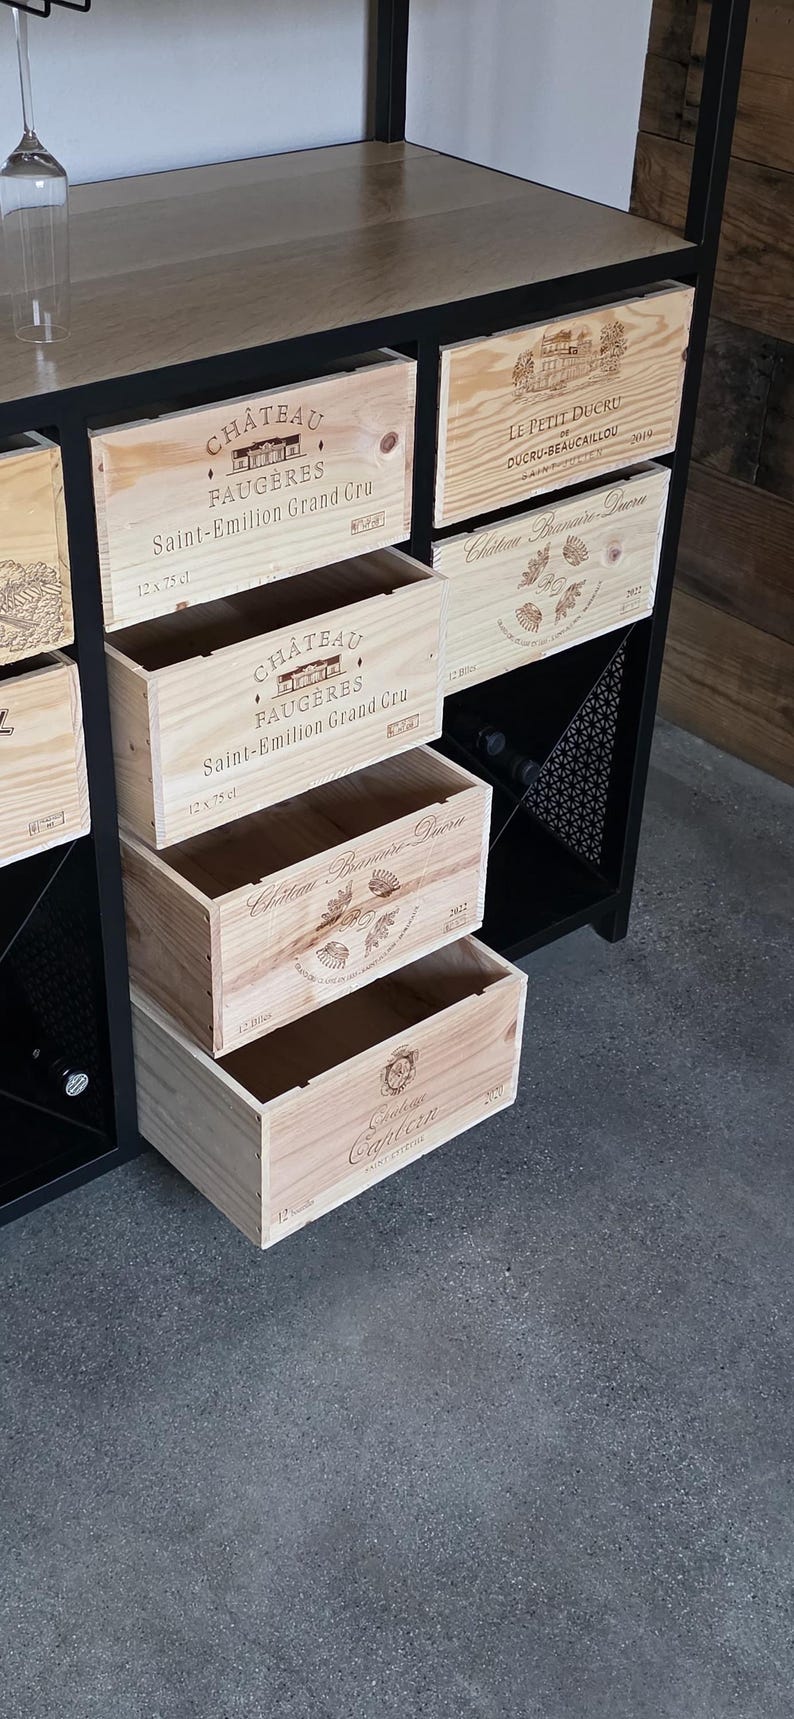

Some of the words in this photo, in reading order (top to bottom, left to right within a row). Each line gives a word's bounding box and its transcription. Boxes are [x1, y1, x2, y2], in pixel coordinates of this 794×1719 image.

[205, 403, 325, 456] CHÂTEAU
[509, 424, 525, 441] LE
[529, 411, 569, 436] PETIT
[571, 396, 621, 424] DUCRU
[560, 428, 570, 438] DE
[507, 425, 619, 470] DUCRU-BEAUCAILLOU
[630, 429, 653, 446] 2019
[208, 460, 325, 508] FAUGÈRES
[153, 505, 282, 556] Saint-Emilion
[288, 487, 338, 518] Grand
[344, 479, 373, 503] Cru
[138, 582, 150, 597] 12
[163, 574, 176, 590] 75
[179, 570, 189, 584] cl
[625, 585, 642, 599] 2022
[253, 630, 363, 683] CHÂTEAU
[449, 670, 457, 681] 12
[255, 675, 363, 730] FAUGÈRES
[203, 720, 322, 777] Saint-Emilion
[328, 700, 376, 729] Grand
[381, 688, 408, 709] Cru
[189, 801, 200, 815] 12
[213, 791, 224, 805] 75
[227, 786, 236, 800] cl
[449, 902, 467, 917] 2022
[239, 1022, 249, 1033] 12
[278, 1208, 288, 1224] 12
